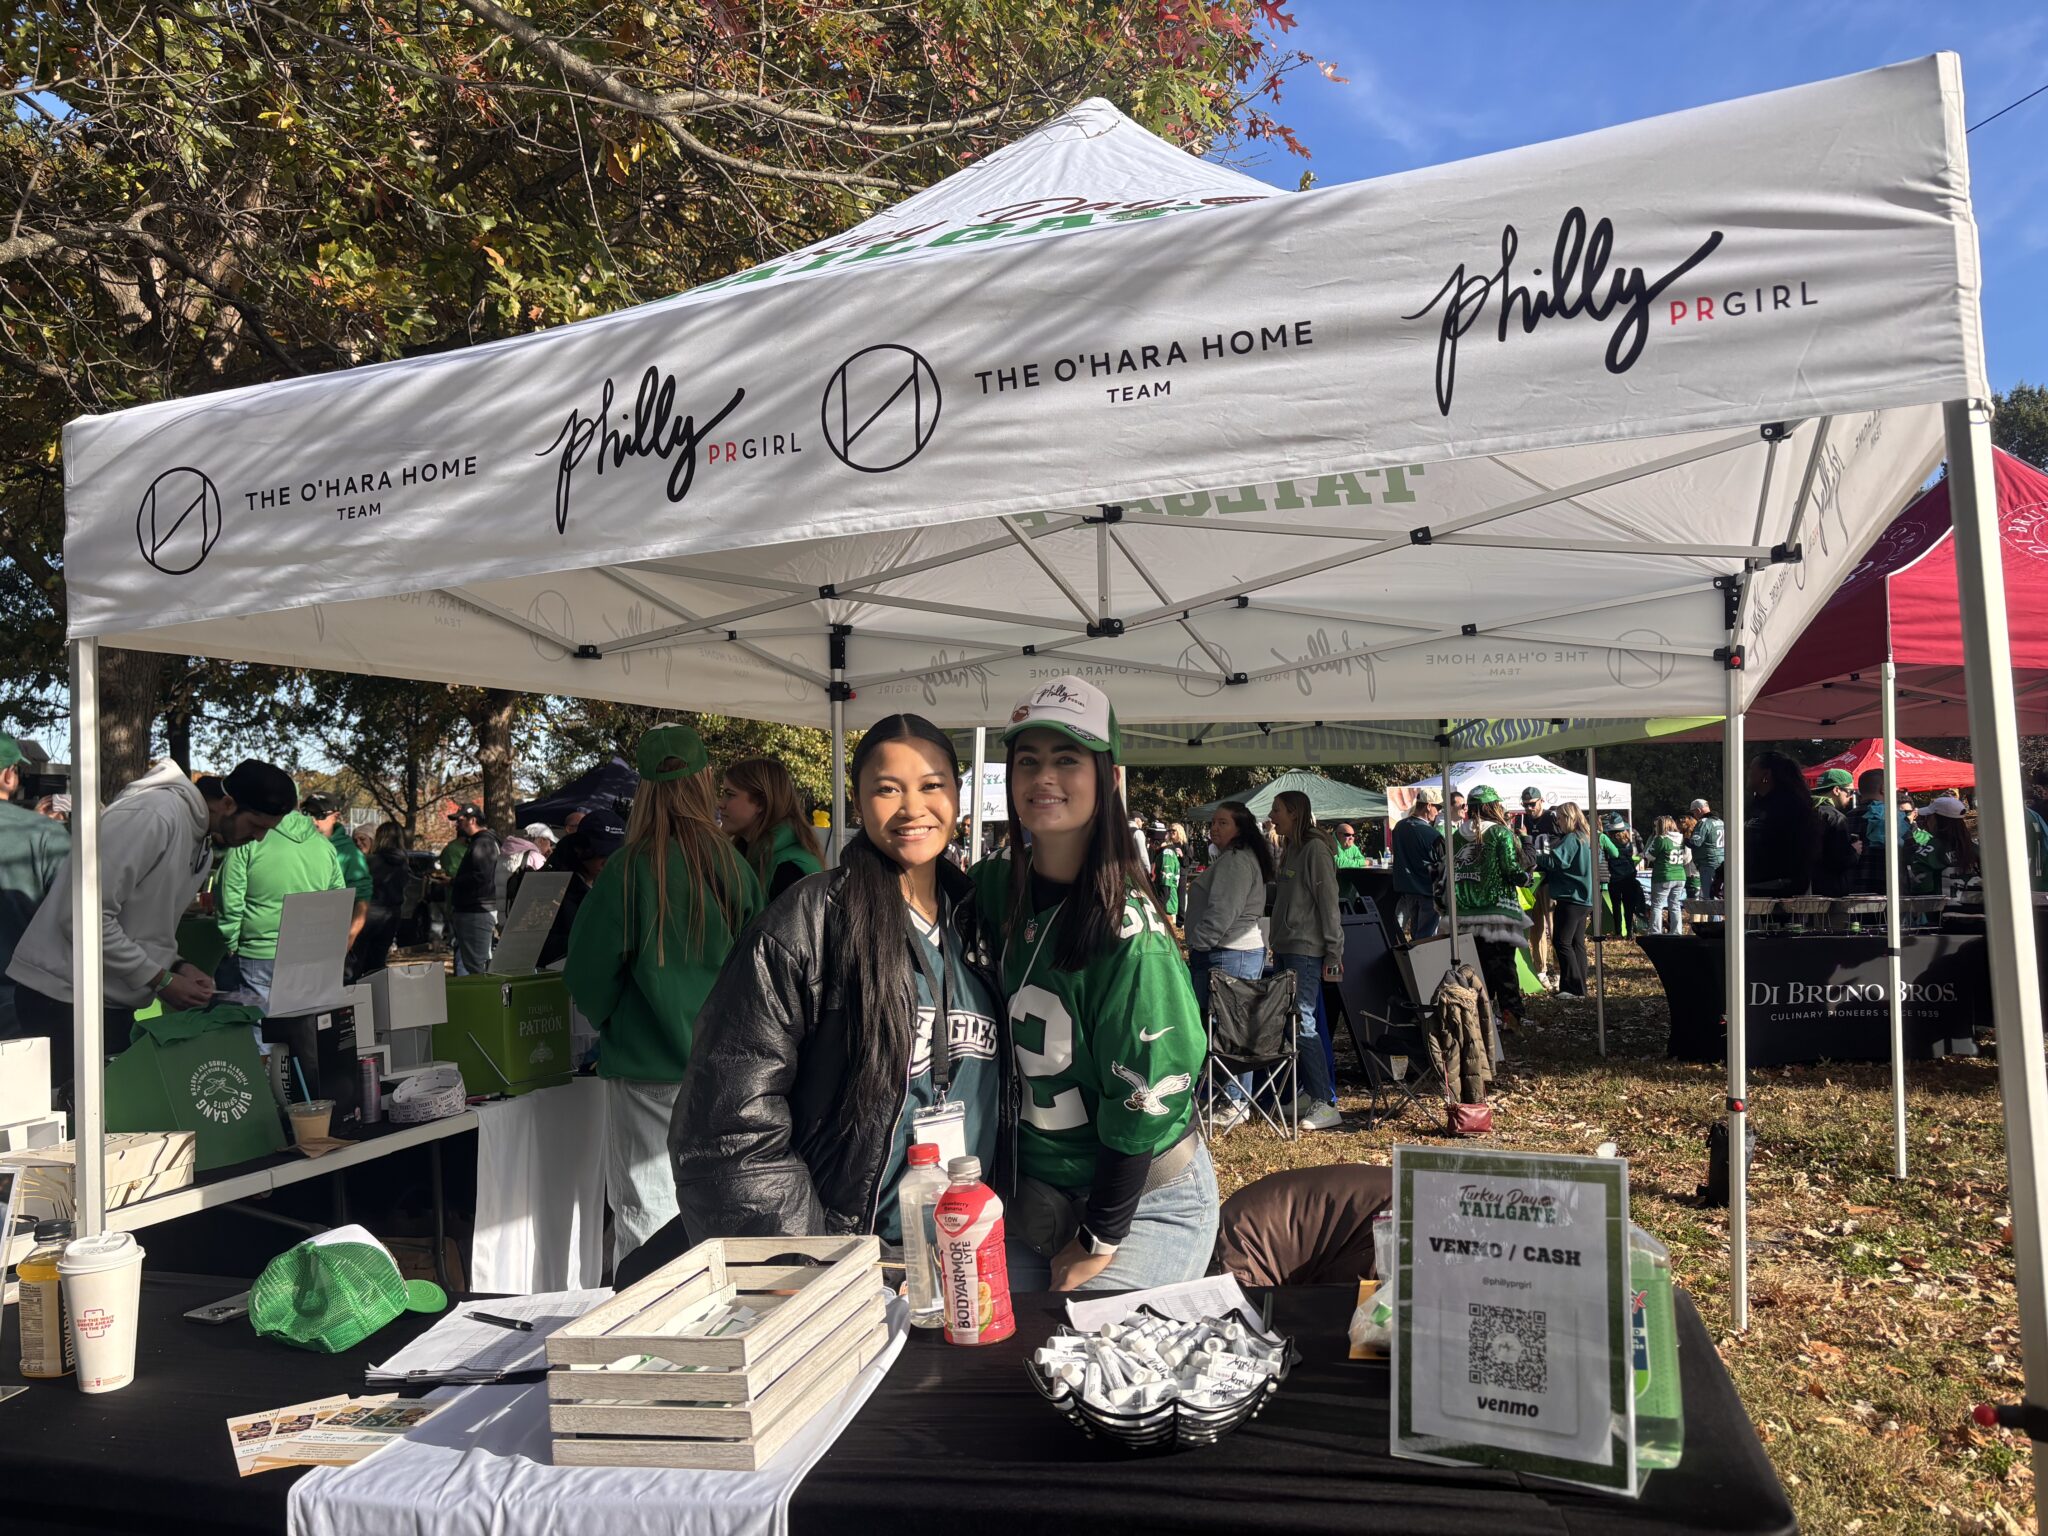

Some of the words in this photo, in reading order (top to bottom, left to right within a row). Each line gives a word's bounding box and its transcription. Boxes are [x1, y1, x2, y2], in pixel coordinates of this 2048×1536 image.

[1401, 206, 1723, 416] philly
[1671, 281, 1818, 325] PRGIRL
[975, 364, 1040, 394] THE
[1054, 340, 1187, 383] O'HARA
[1202, 320, 1314, 360] HOME
[1106, 380, 1172, 404] TEAM
[535, 365, 746, 535] philly
[708, 432, 802, 465] PRGIRL
[245, 487, 291, 511] THE
[300, 471, 392, 502] O'HARA
[402, 456, 477, 486] HOME
[337, 502, 381, 520] TEAM
[1770, 1011, 1823, 1021] CULINARY
[1827, 1009, 1879, 1018] PIONEERS
[1883, 1009, 1913, 1018] SCE
[1917, 1010, 1940, 1019] 1939
[913, 1011, 998, 1062] EGLES
[196, 1098, 229, 1123] GANG
[213, 1096, 238, 1109] SPIRITS
[231, 1091, 253, 1120] BIRD
[1459, 1184, 1504, 1206] Turkey
[1507, 1187, 1540, 1207] Day
[1459, 1200, 1557, 1224] TAILGATE
[963, 1241, 974, 1265] LYTE
[1429, 1236, 1503, 1260] VENMO
[1522, 1245, 1582, 1267] CASH
[949, 1241, 970, 1329] BODYARMOR
[1477, 1396, 1540, 1418] venmo
